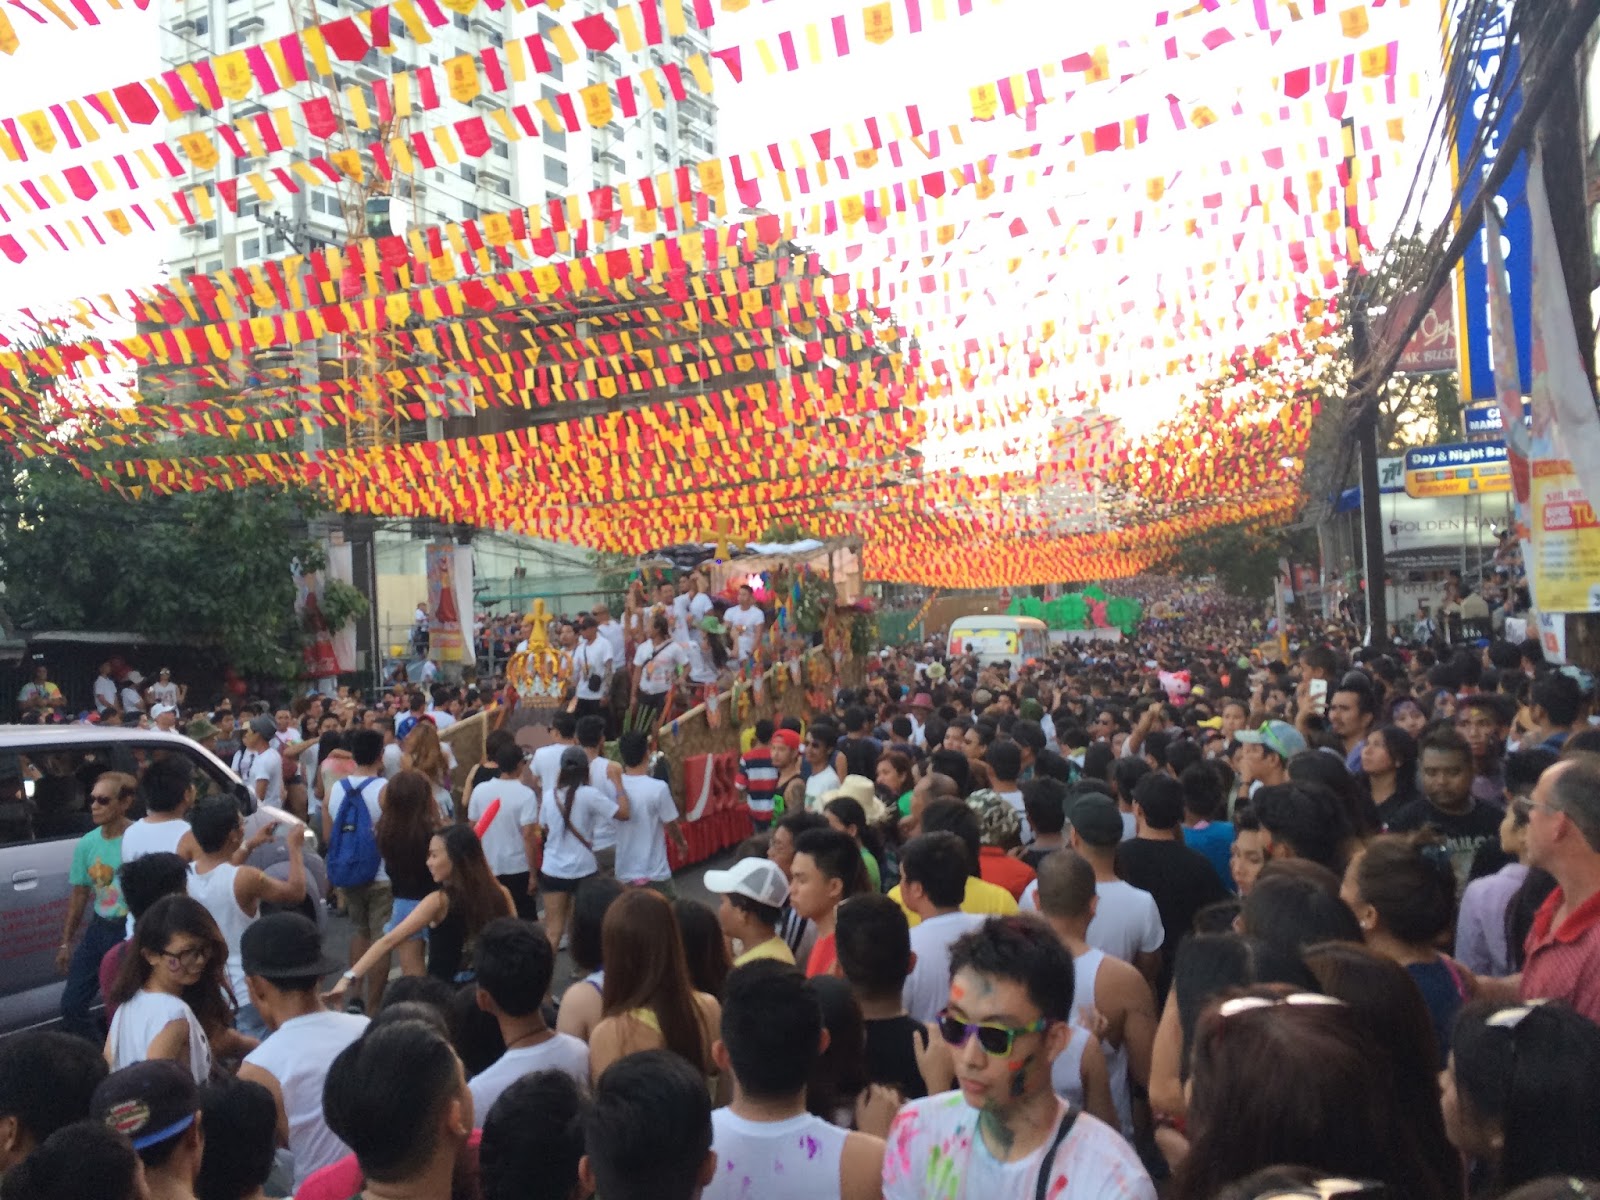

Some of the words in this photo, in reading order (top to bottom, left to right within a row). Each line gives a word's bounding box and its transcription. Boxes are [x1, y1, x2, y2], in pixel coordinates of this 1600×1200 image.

[1412, 453, 1436, 465] Day
[1438, 451, 1447, 462] &
[1449, 448, 1485, 462] Night
